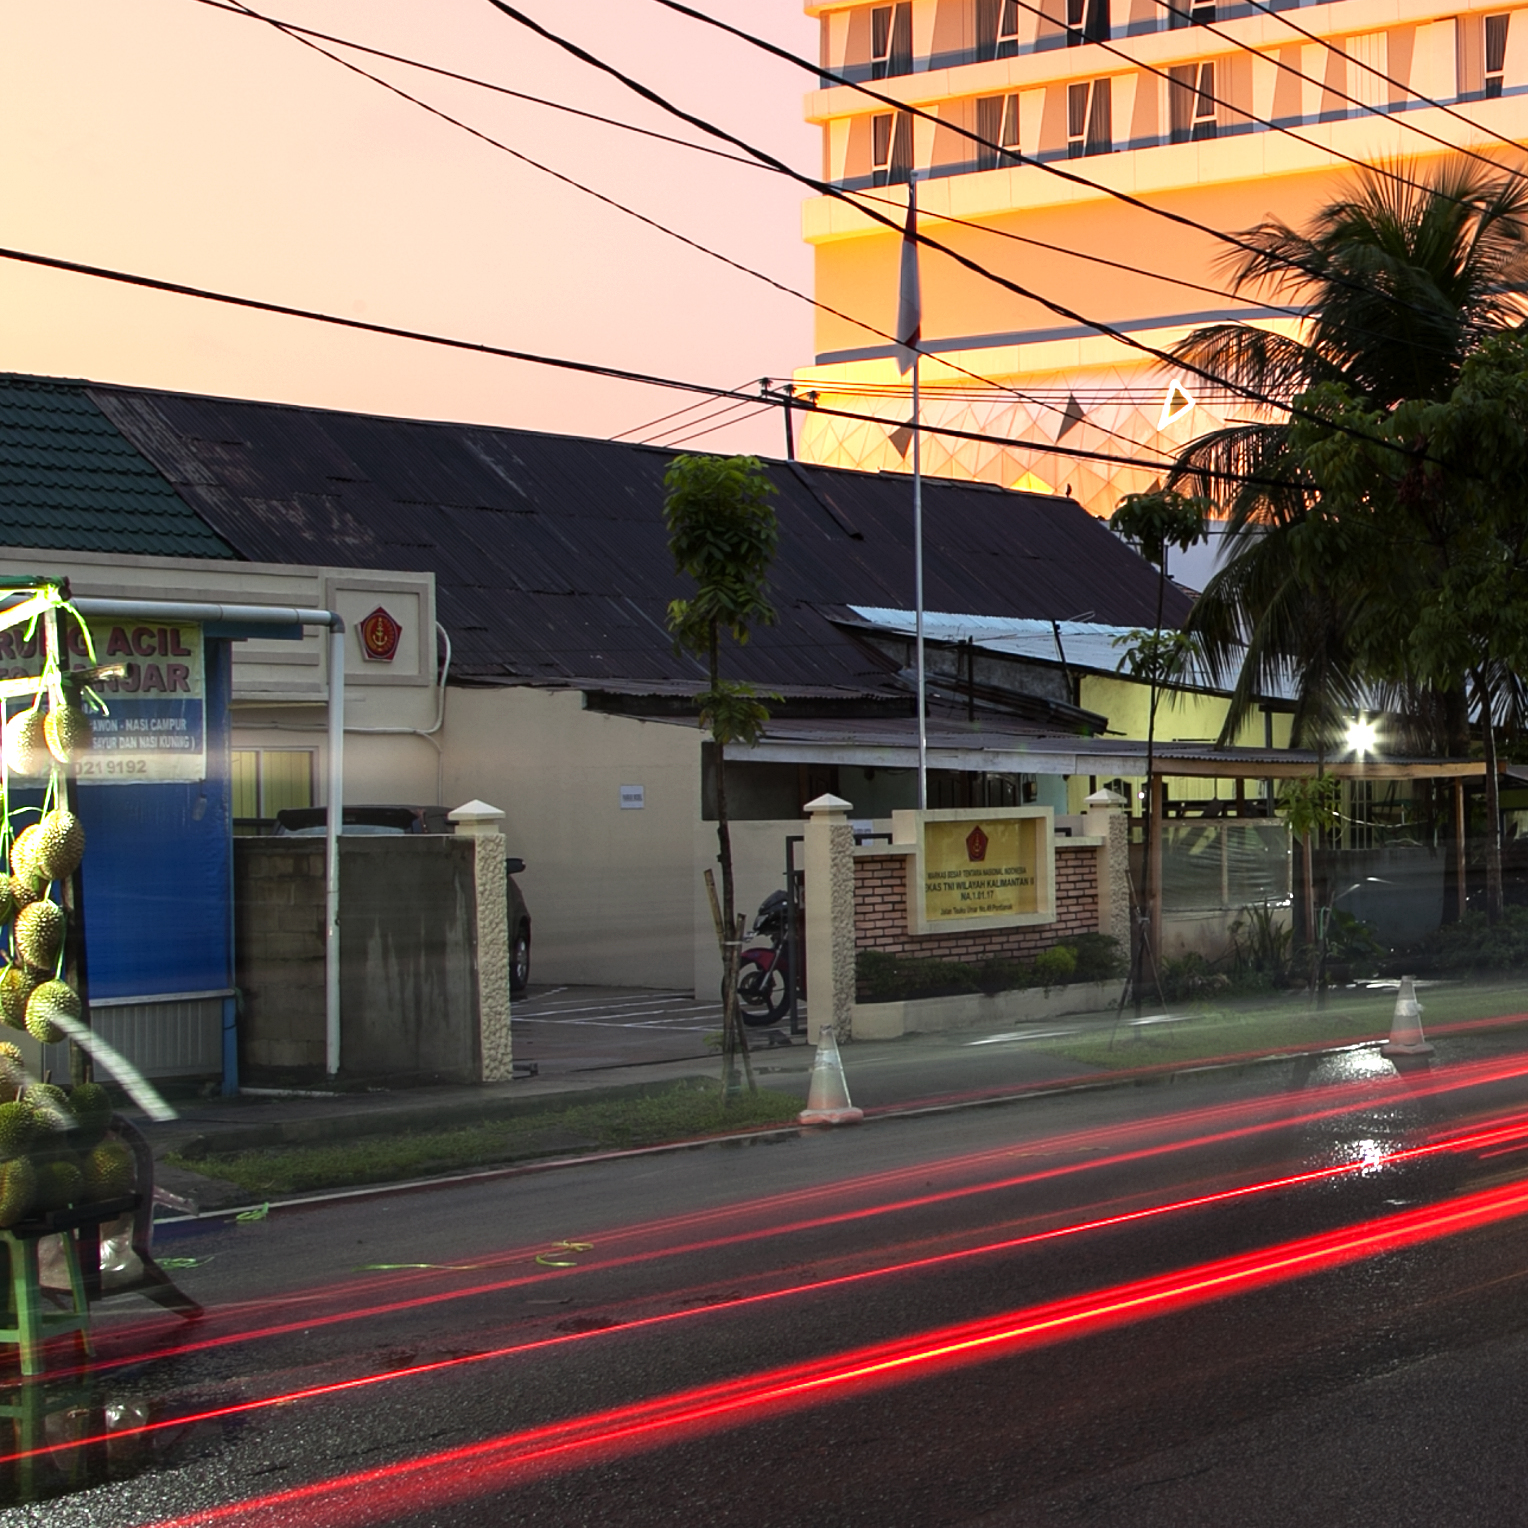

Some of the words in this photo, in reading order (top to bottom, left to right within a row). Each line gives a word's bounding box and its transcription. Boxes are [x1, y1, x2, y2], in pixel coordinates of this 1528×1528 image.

[0, 625, 94, 661] RUG
[106, 626, 191, 657] ACIL
[89, 719, 118, 732] AWON
[125, 719, 148, 731] NASI
[150, 718, 187, 731] CAMPUR
[119, 737, 137, 749] DAN
[139, 736, 157, 748] NASI
[160, 735, 189, 748] KUNING
[943, 882, 955, 892] TNI
[956, 880, 986, 890] WILAYAH
[986, 877, 1029, 888] KALIMANTAN
